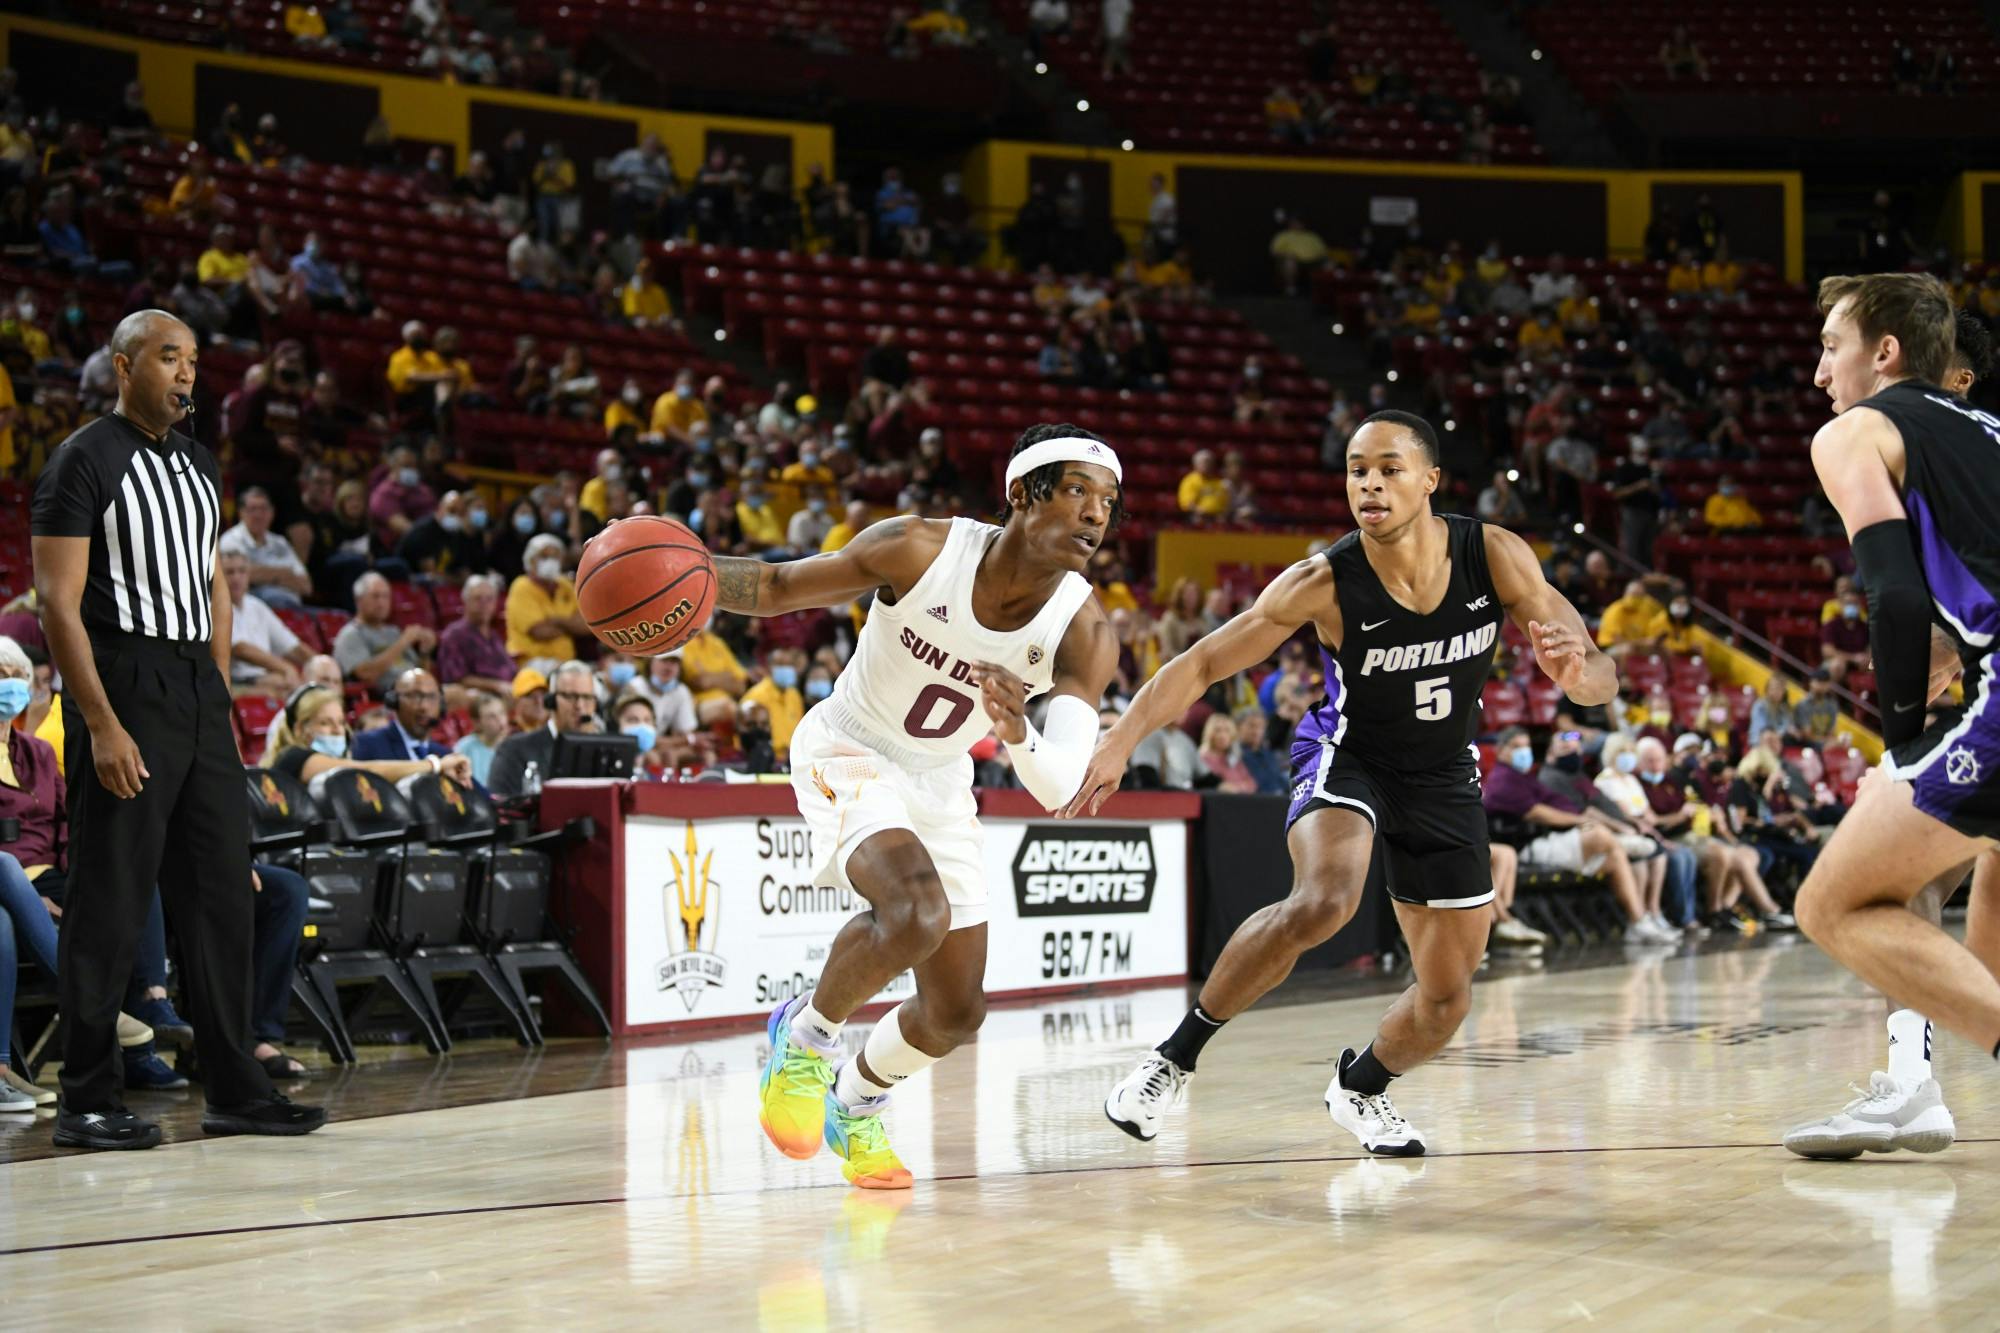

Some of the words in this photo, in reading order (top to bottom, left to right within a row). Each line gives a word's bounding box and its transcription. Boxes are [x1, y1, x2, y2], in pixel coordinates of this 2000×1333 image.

[604, 598, 693, 646] Wilson
[926, 608, 949, 624] adidas
[900, 626, 950, 671] SUN
[1360, 621, 1497, 677] PORTLAND
[903, 683, 975, 739] 0
[1414, 675, 1452, 721] 5
[1019, 840, 1151, 872] ARIZONA
[1024, 873, 1146, 905] SPORTS
[1042, 930, 1094, 979] 98.7
[1100, 931, 1133, 974] FM
